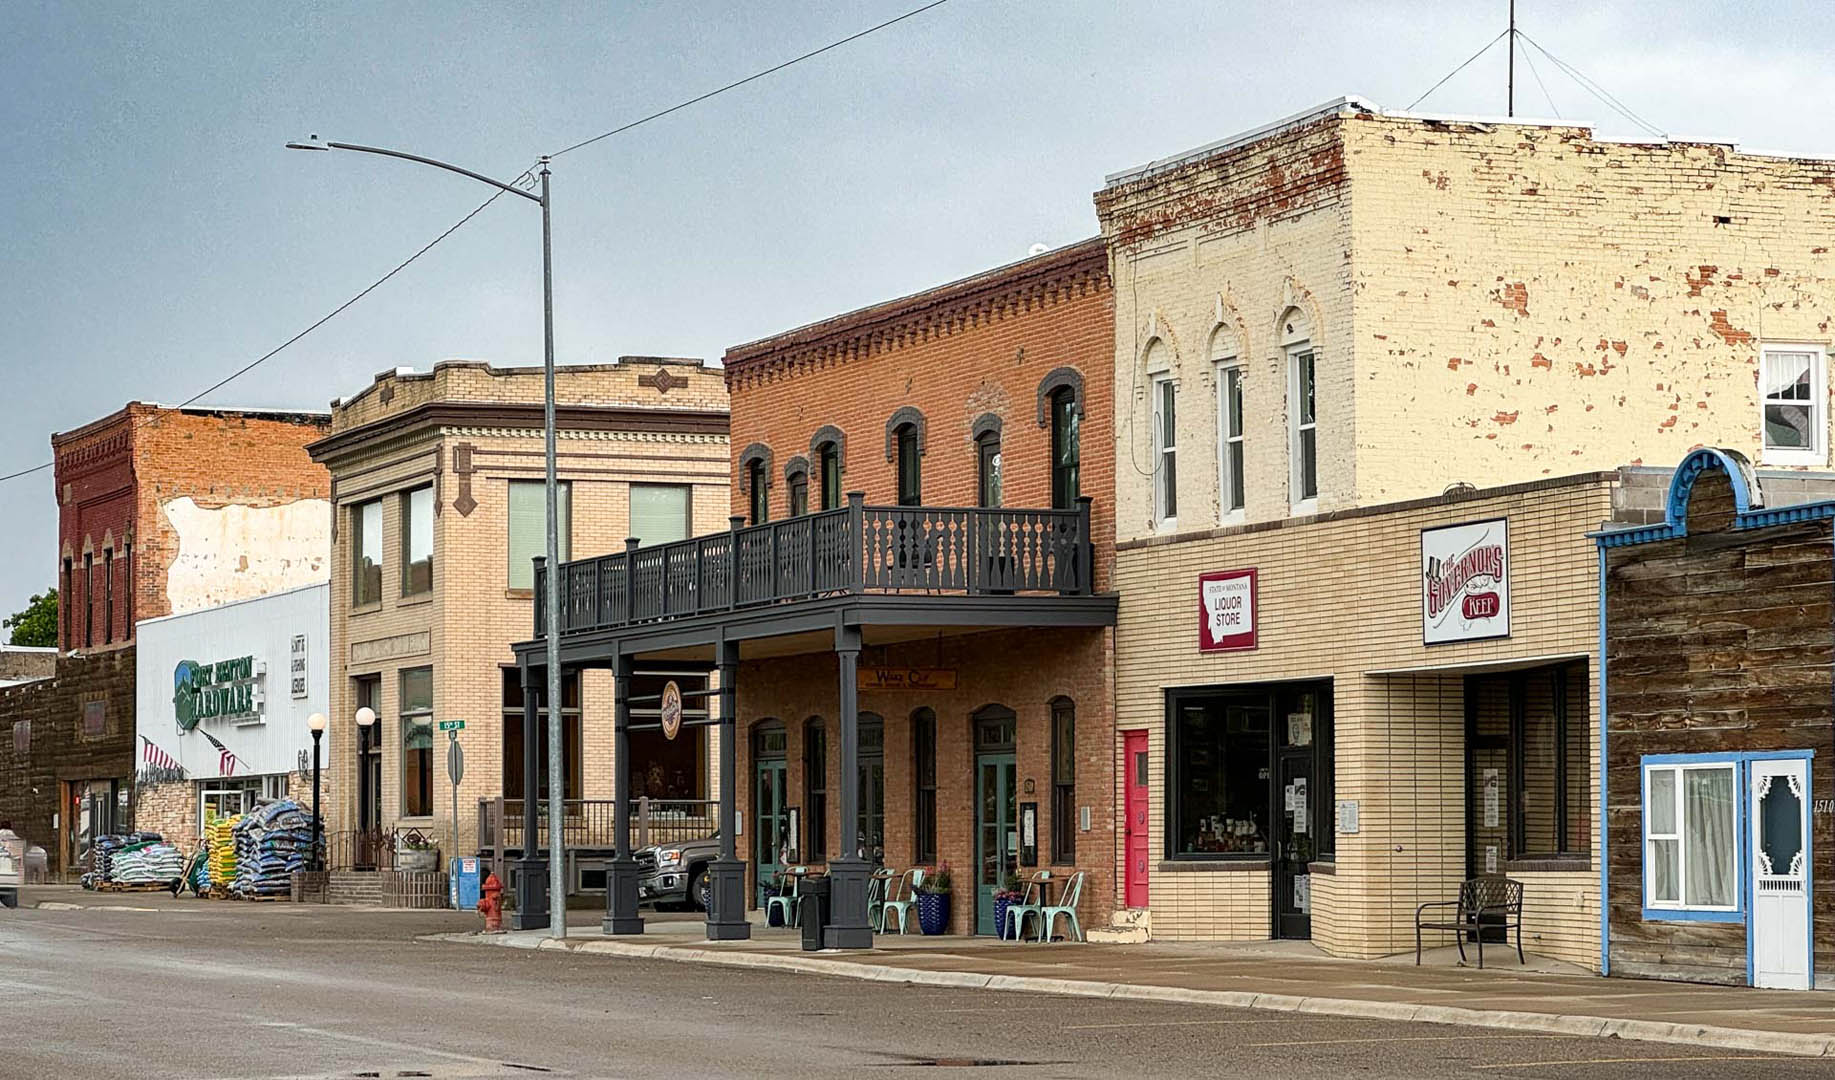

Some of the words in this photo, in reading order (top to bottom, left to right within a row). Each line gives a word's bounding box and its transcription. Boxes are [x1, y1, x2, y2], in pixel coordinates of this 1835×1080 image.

[1441, 553, 1455, 576] THE
[1226, 583, 1248, 591] MONTANA
[1214, 596, 1242, 610] LIQUOR
[1469, 597, 1494, 616] KEEP
[1216, 612, 1240, 626] STORE
[191, 664, 213, 688] FORT
[215, 655, 252, 682] BENTON
[191, 684, 252, 719] HARDWARE
[1813, 800, 1834, 813] 1510
